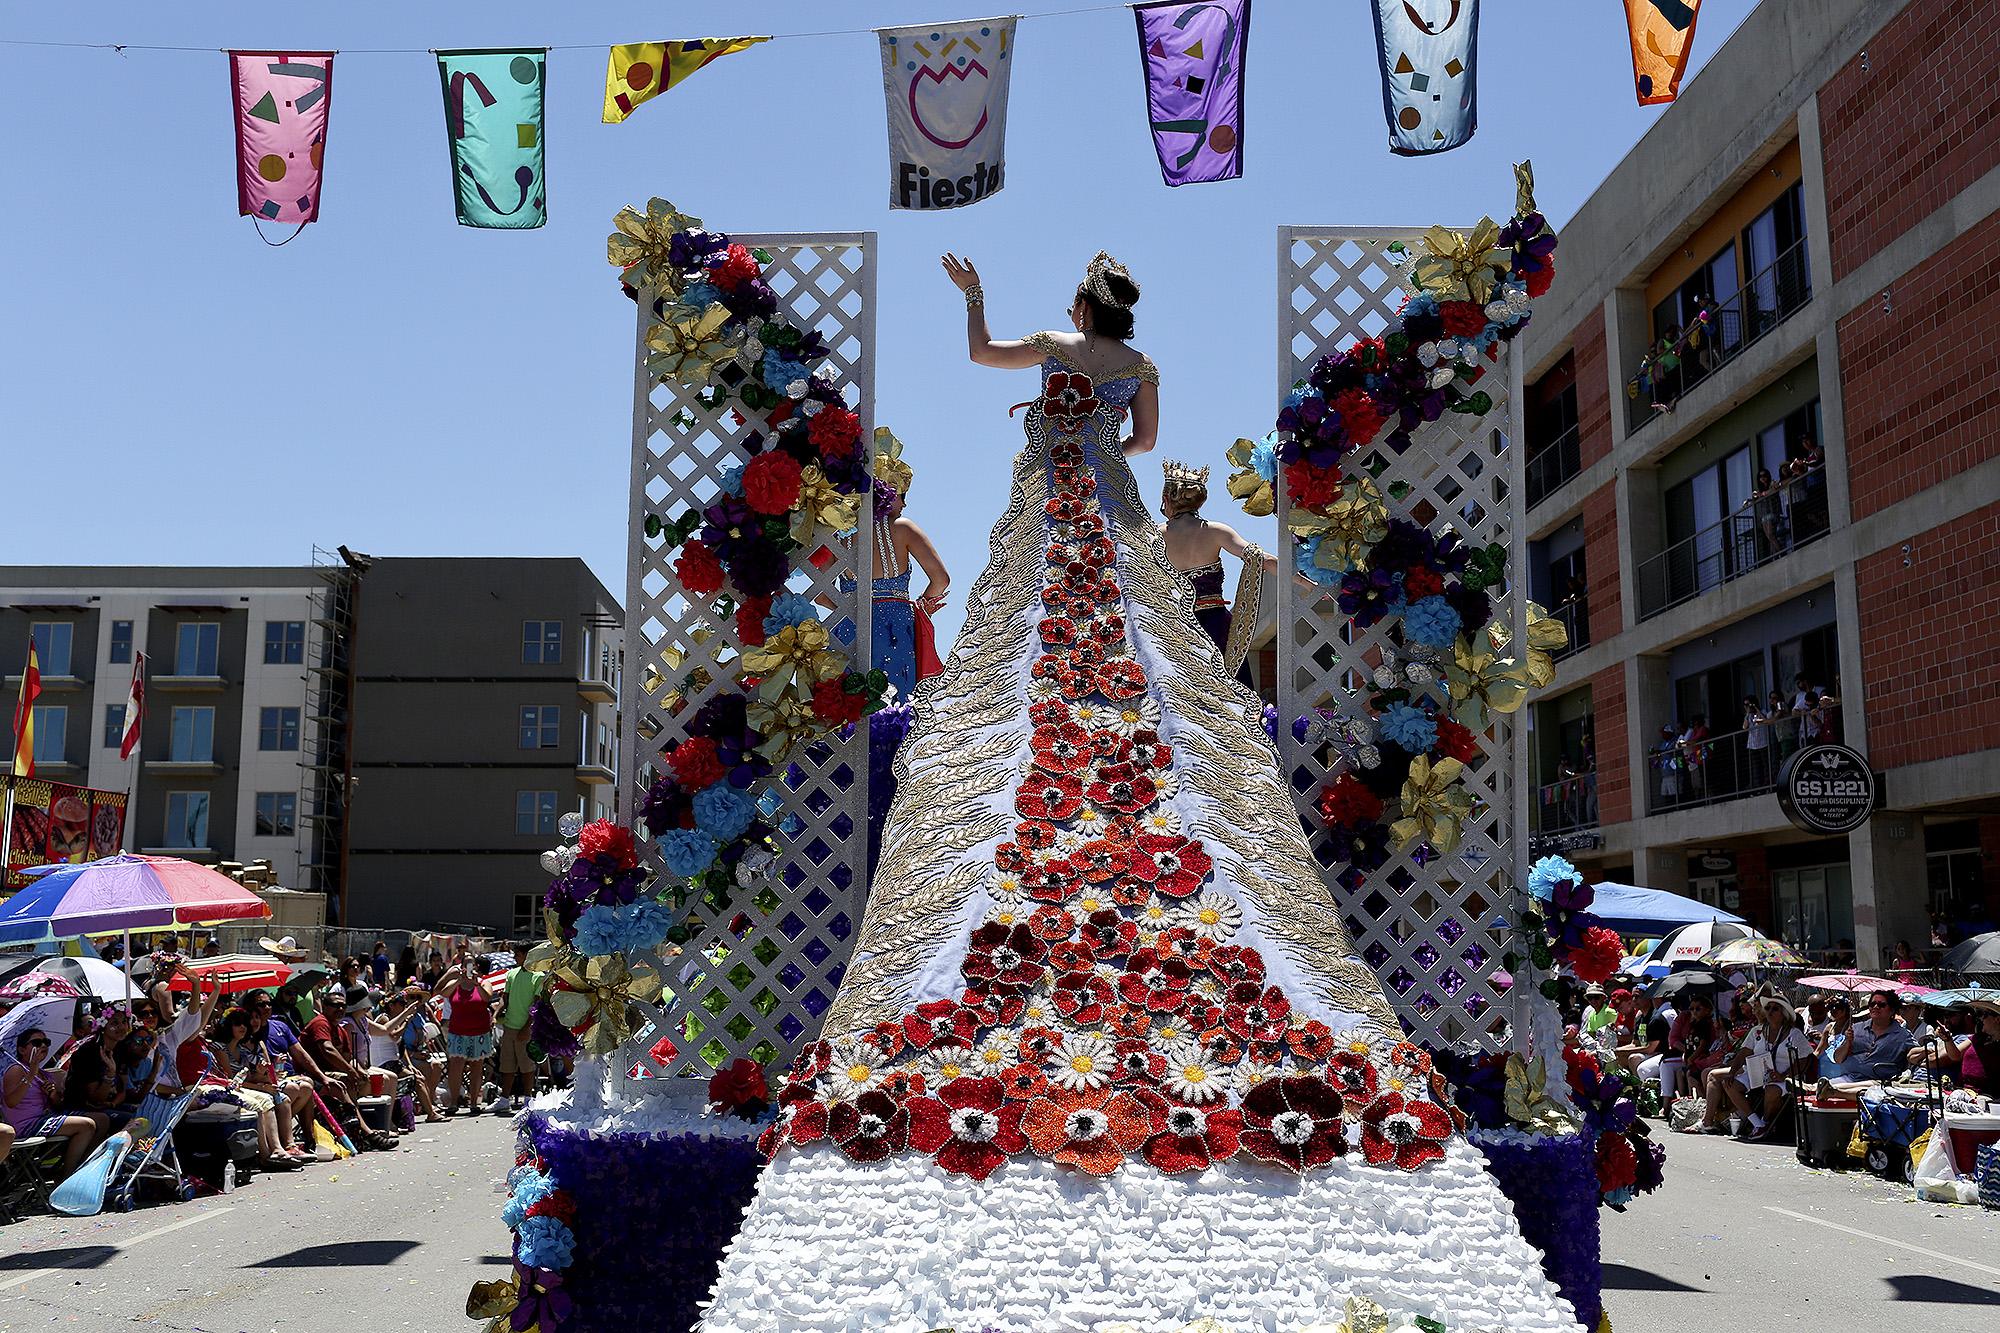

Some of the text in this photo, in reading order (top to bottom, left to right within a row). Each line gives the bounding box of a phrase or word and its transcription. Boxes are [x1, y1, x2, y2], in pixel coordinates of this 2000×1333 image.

[900, 162, 999, 208] Fiesta
[15, 785, 50, 808] Grilled
[1801, 797, 1818, 805] BEER
[1828, 797, 1866, 805] DISCIPLINE
[9, 848, 45, 865] Chicken
